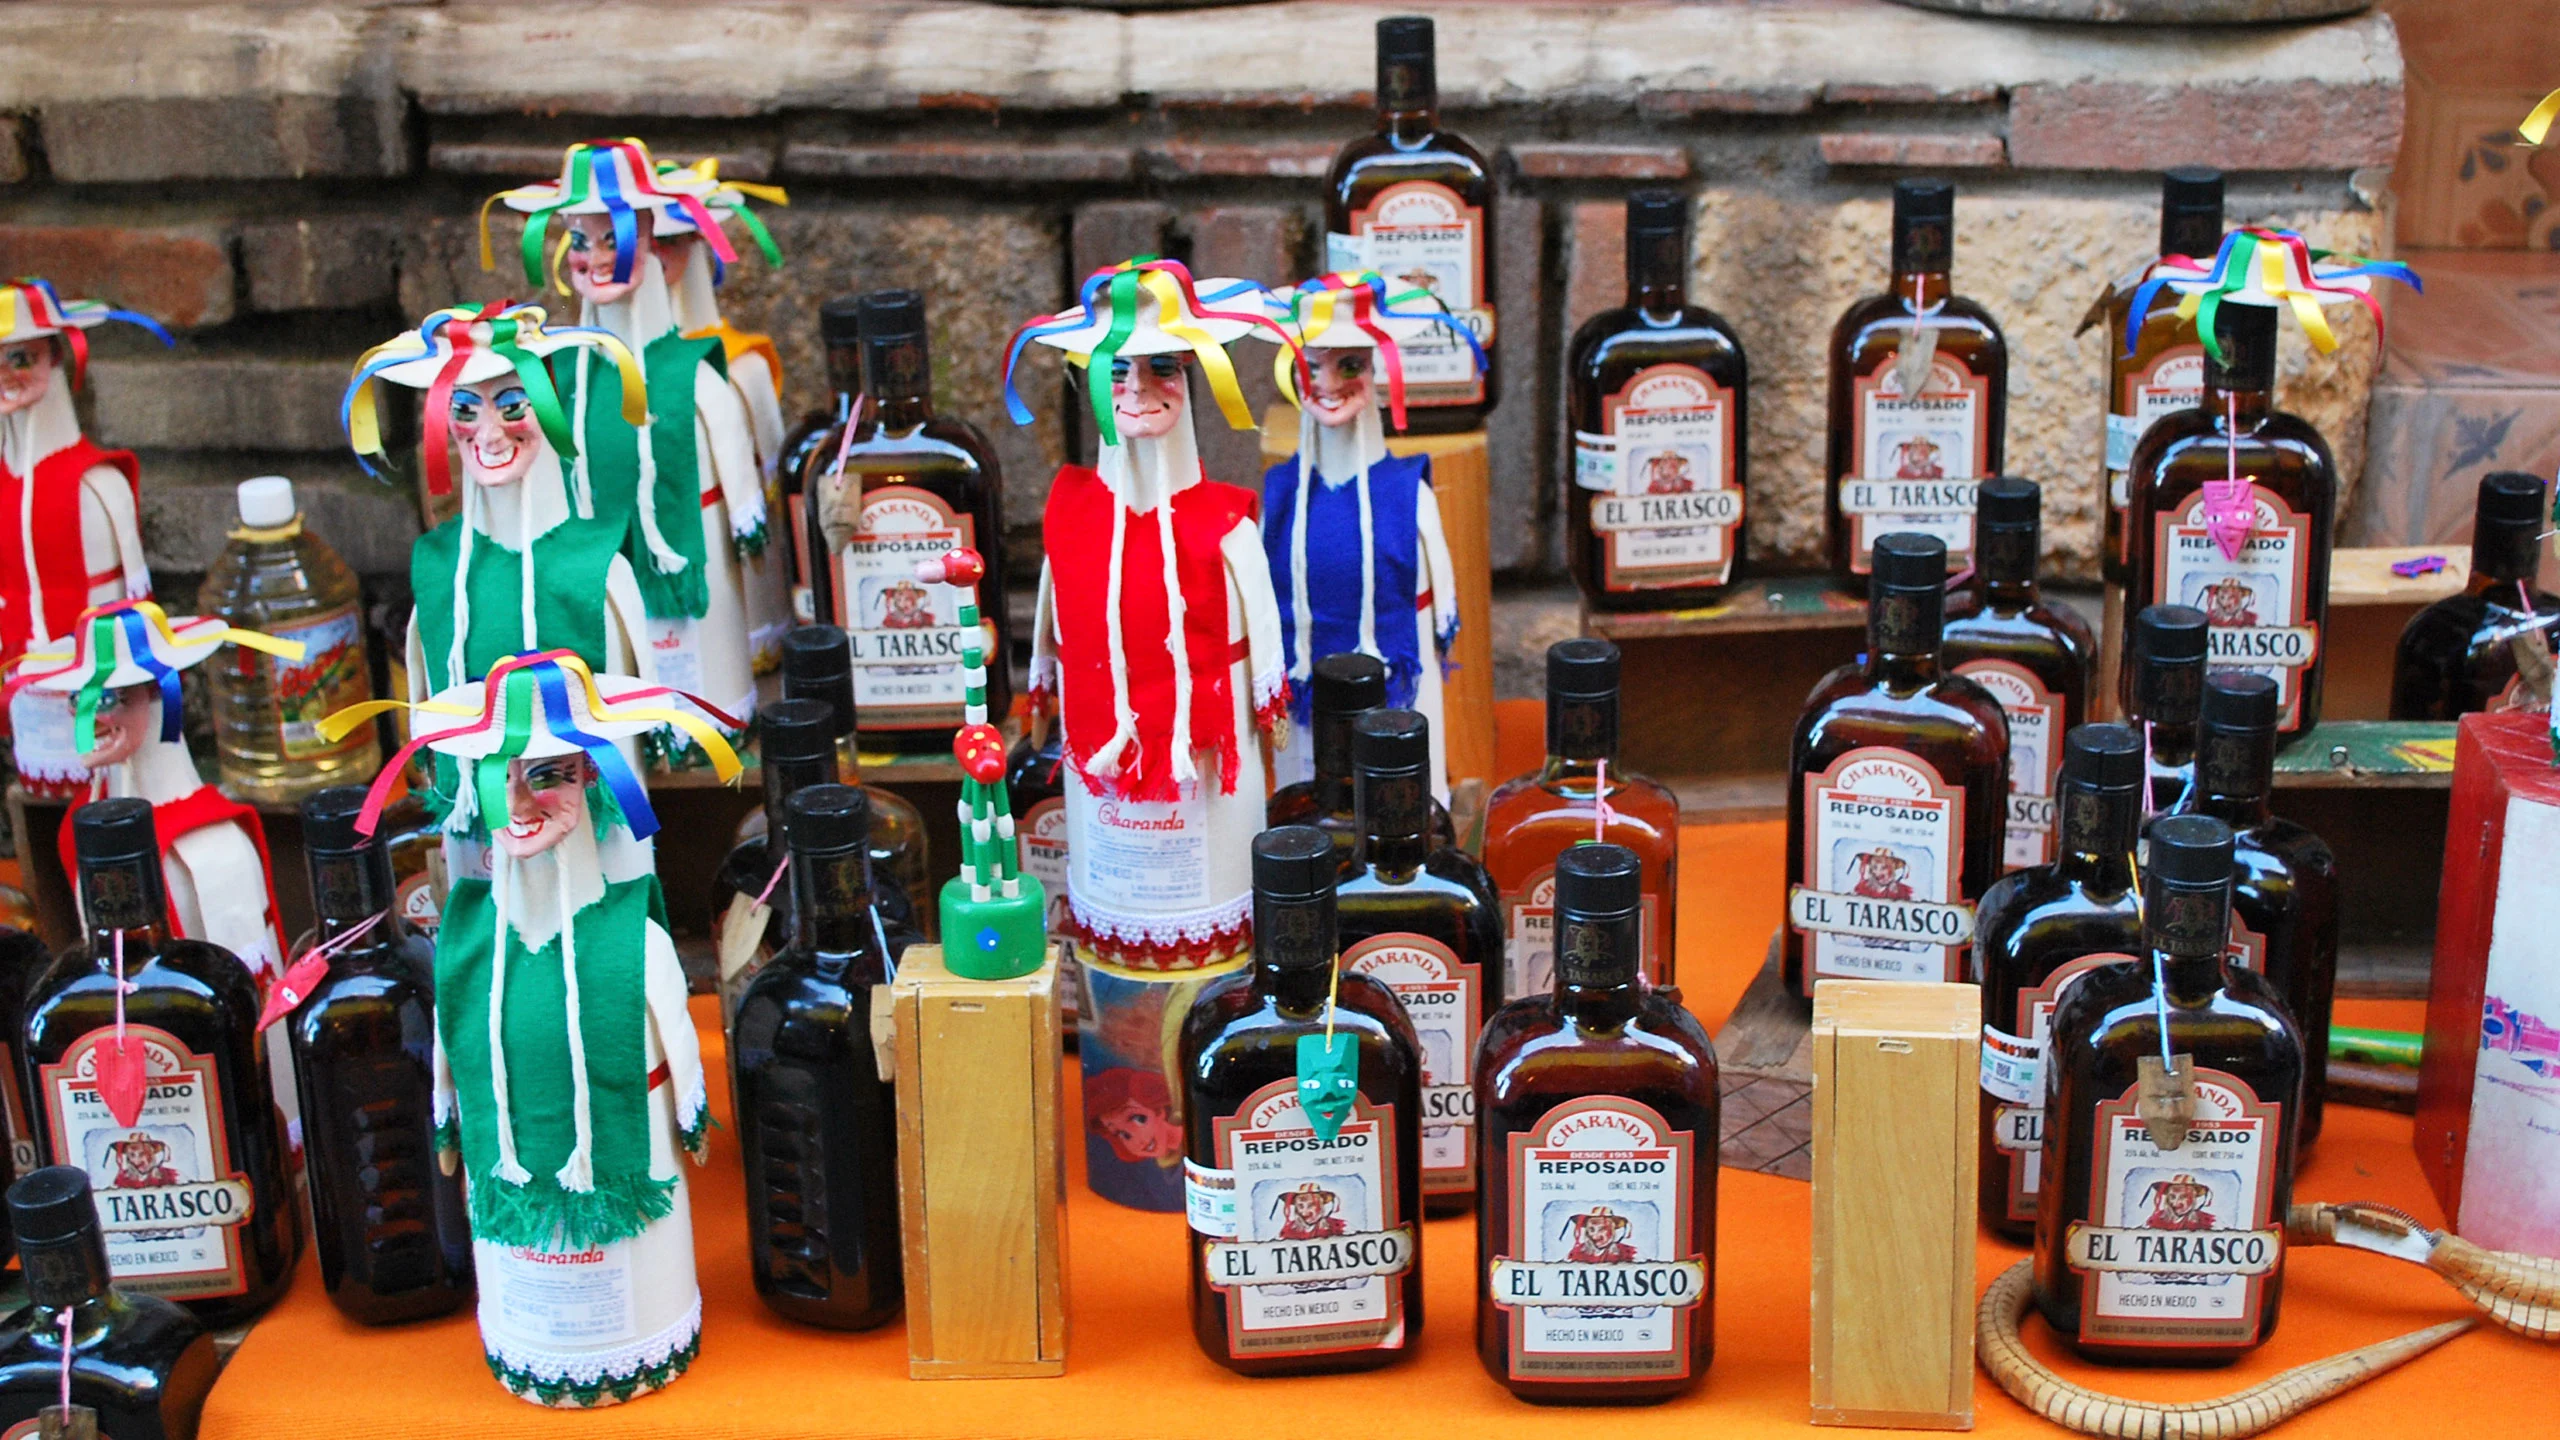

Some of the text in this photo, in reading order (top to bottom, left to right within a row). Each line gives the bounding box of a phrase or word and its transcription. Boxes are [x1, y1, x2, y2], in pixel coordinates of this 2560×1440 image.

[1375, 231, 1464, 243] REPOSADO
[1876, 400, 1968, 411] REPOSADO
[2148, 396, 2202, 406] REPOS
[1625, 414, 1714, 426] REPOSADO
[1854, 486, 1876, 506] EL
[1606, 496, 1731, 524] EL TARASCO
[853, 541, 953, 554] REPOSADO
[2180, 537, 2285, 550] REPADO
[877, 632, 962, 657] TARASC
[2207, 632, 2301, 657] ARASCO
[1974, 674, 2029, 704] ARANDA
[1841, 763, 1925, 797] CHARANDA
[1098, 802, 1185, 831] Charanda
[1830, 802, 1940, 823] REPOSADO
[1805, 897, 1960, 936] EL TARASCO
[1360, 951, 1442, 981] HARANDA
[1400, 992, 1457, 1005] SADO
[73, 1085, 193, 1104] READO
[2193, 1086, 2238, 1119] ANDA
[1551, 1115, 1650, 1148] CHARANDA
[2013, 1116, 2043, 1141] EL
[2125, 1129, 2251, 1144] RESADO
[1245, 1134, 1368, 1155] REPOSADO
[1569, 1151, 1606, 1159] DESDE
[1539, 1161, 1666, 1175] REPOSADO
[108, 1188, 232, 1223] TARASCO
[110, 1253, 134, 1267] ECHO
[1225, 1237, 1398, 1277] EL TARASCO
[2087, 1234, 2264, 1265] EL TARASCO
[1511, 1268, 1688, 1298] EL TARASCO
[1263, 1301, 1340, 1318] HECHO EN MEXICO
[2118, 1294, 2197, 1309] HECHO EN MEXICO
[1546, 1329, 1624, 1342] HECHO EN MEXICO
